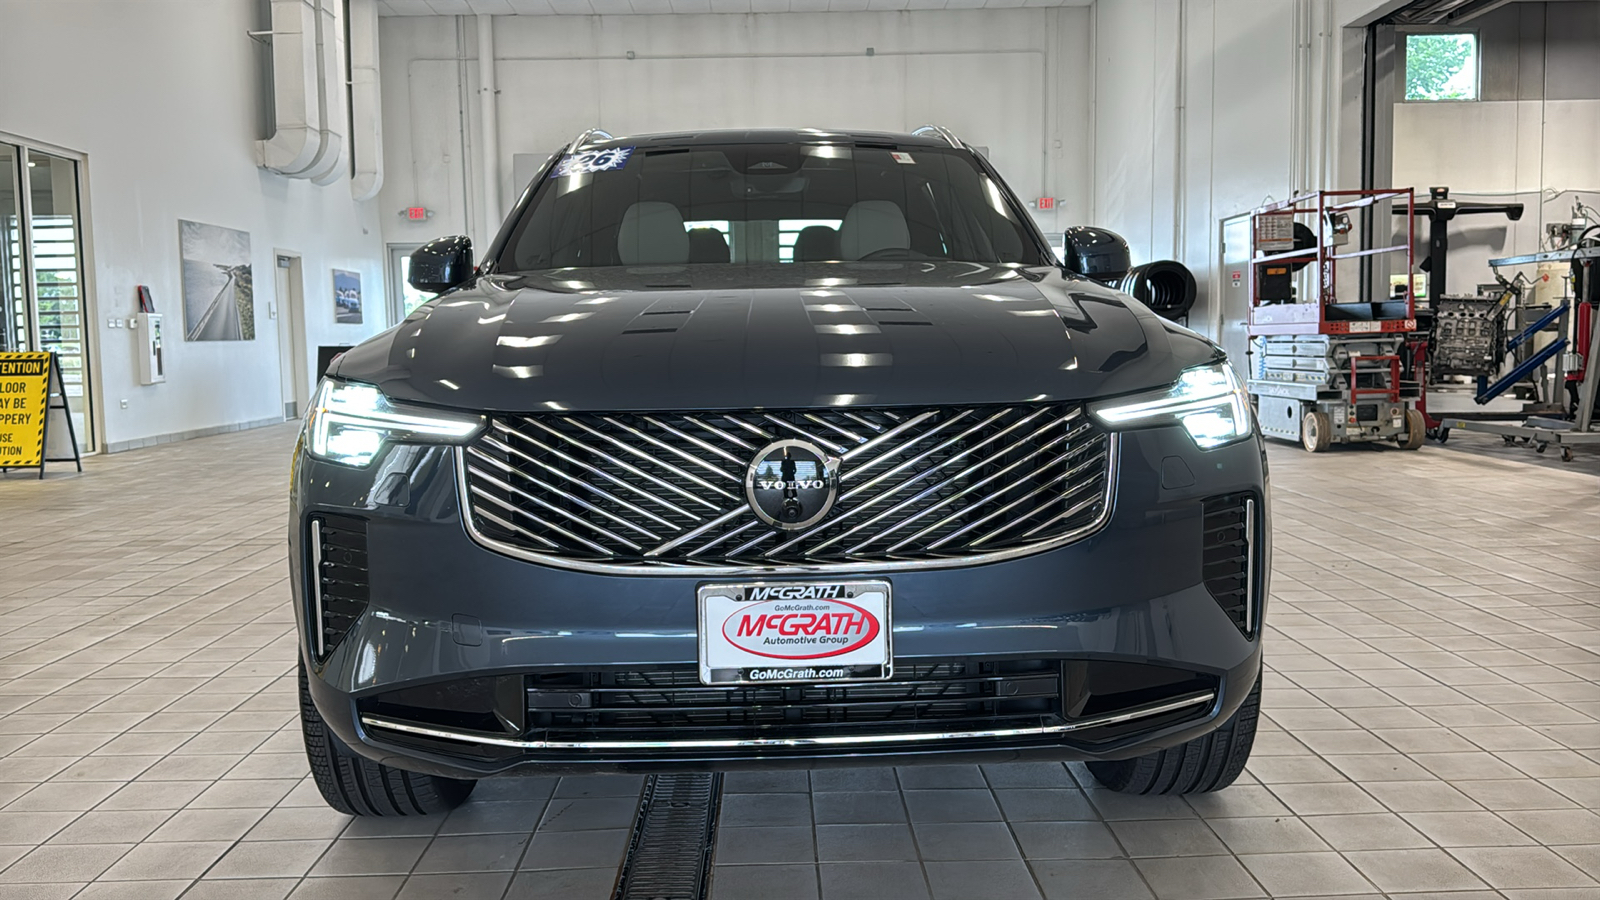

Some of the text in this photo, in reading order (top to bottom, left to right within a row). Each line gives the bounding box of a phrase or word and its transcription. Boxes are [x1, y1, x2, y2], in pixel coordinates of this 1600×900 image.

[1039, 197, 1053, 209] EXIT
[409, 207, 424, 219] EXIT
[0, 361, 41, 374] ENTION
[13, 397, 27, 409] BE
[759, 480, 824, 490] VOLVO
[763, 635, 849, 646] Automotive Group
[749, 667, 844, 680] GoMcGrath.com
